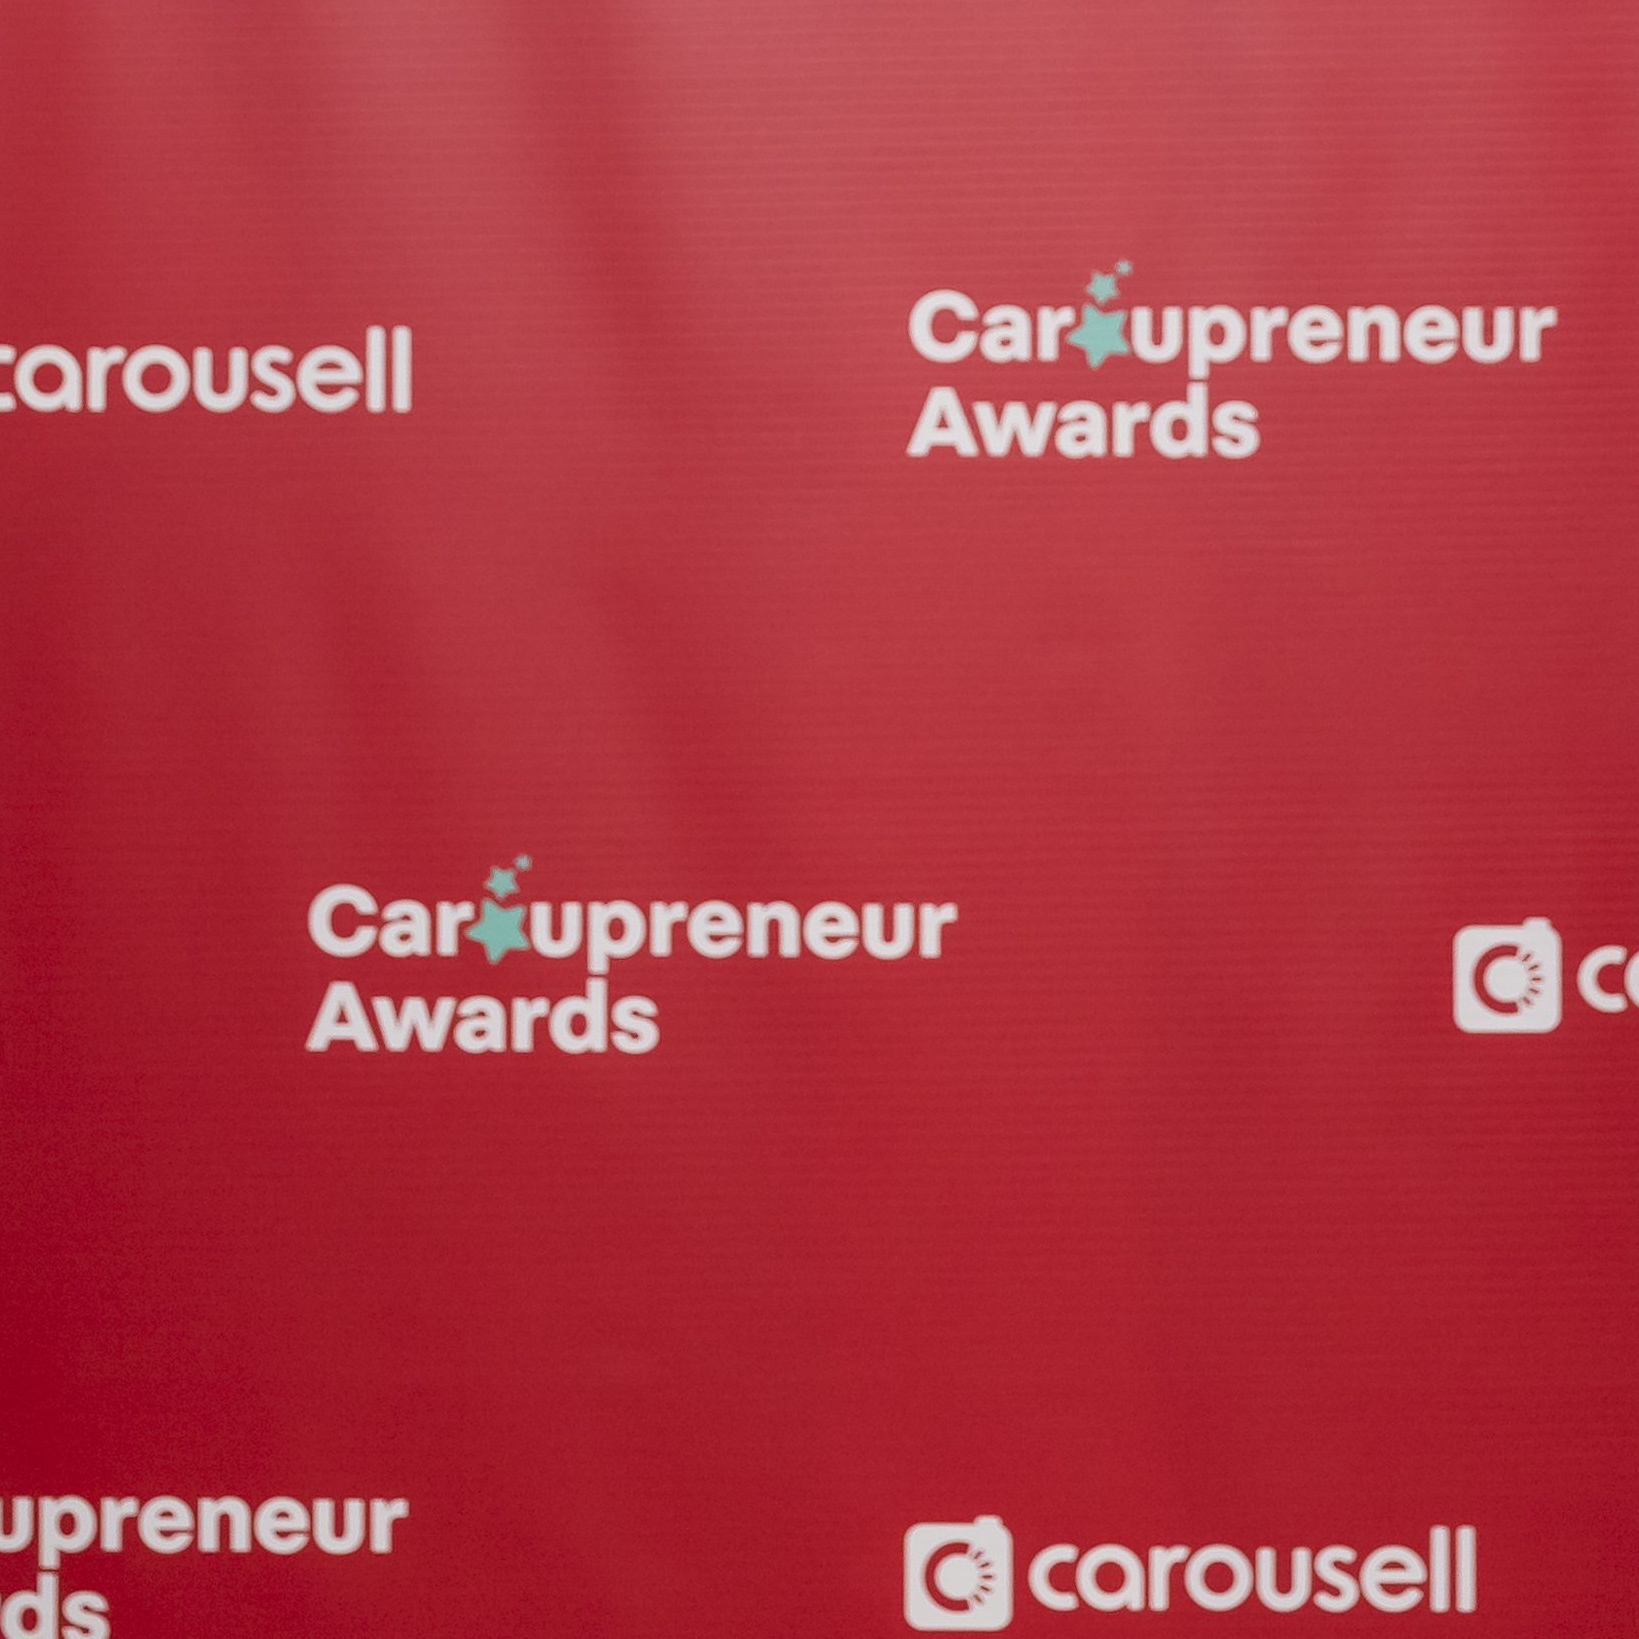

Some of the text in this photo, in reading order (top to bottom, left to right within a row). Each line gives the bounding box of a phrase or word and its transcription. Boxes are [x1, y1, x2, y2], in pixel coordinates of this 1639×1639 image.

[904, 380, 1262, 461] Awards
[305, 976, 661, 1056] Awards
[1027, 1524, 1478, 1614] carousell
